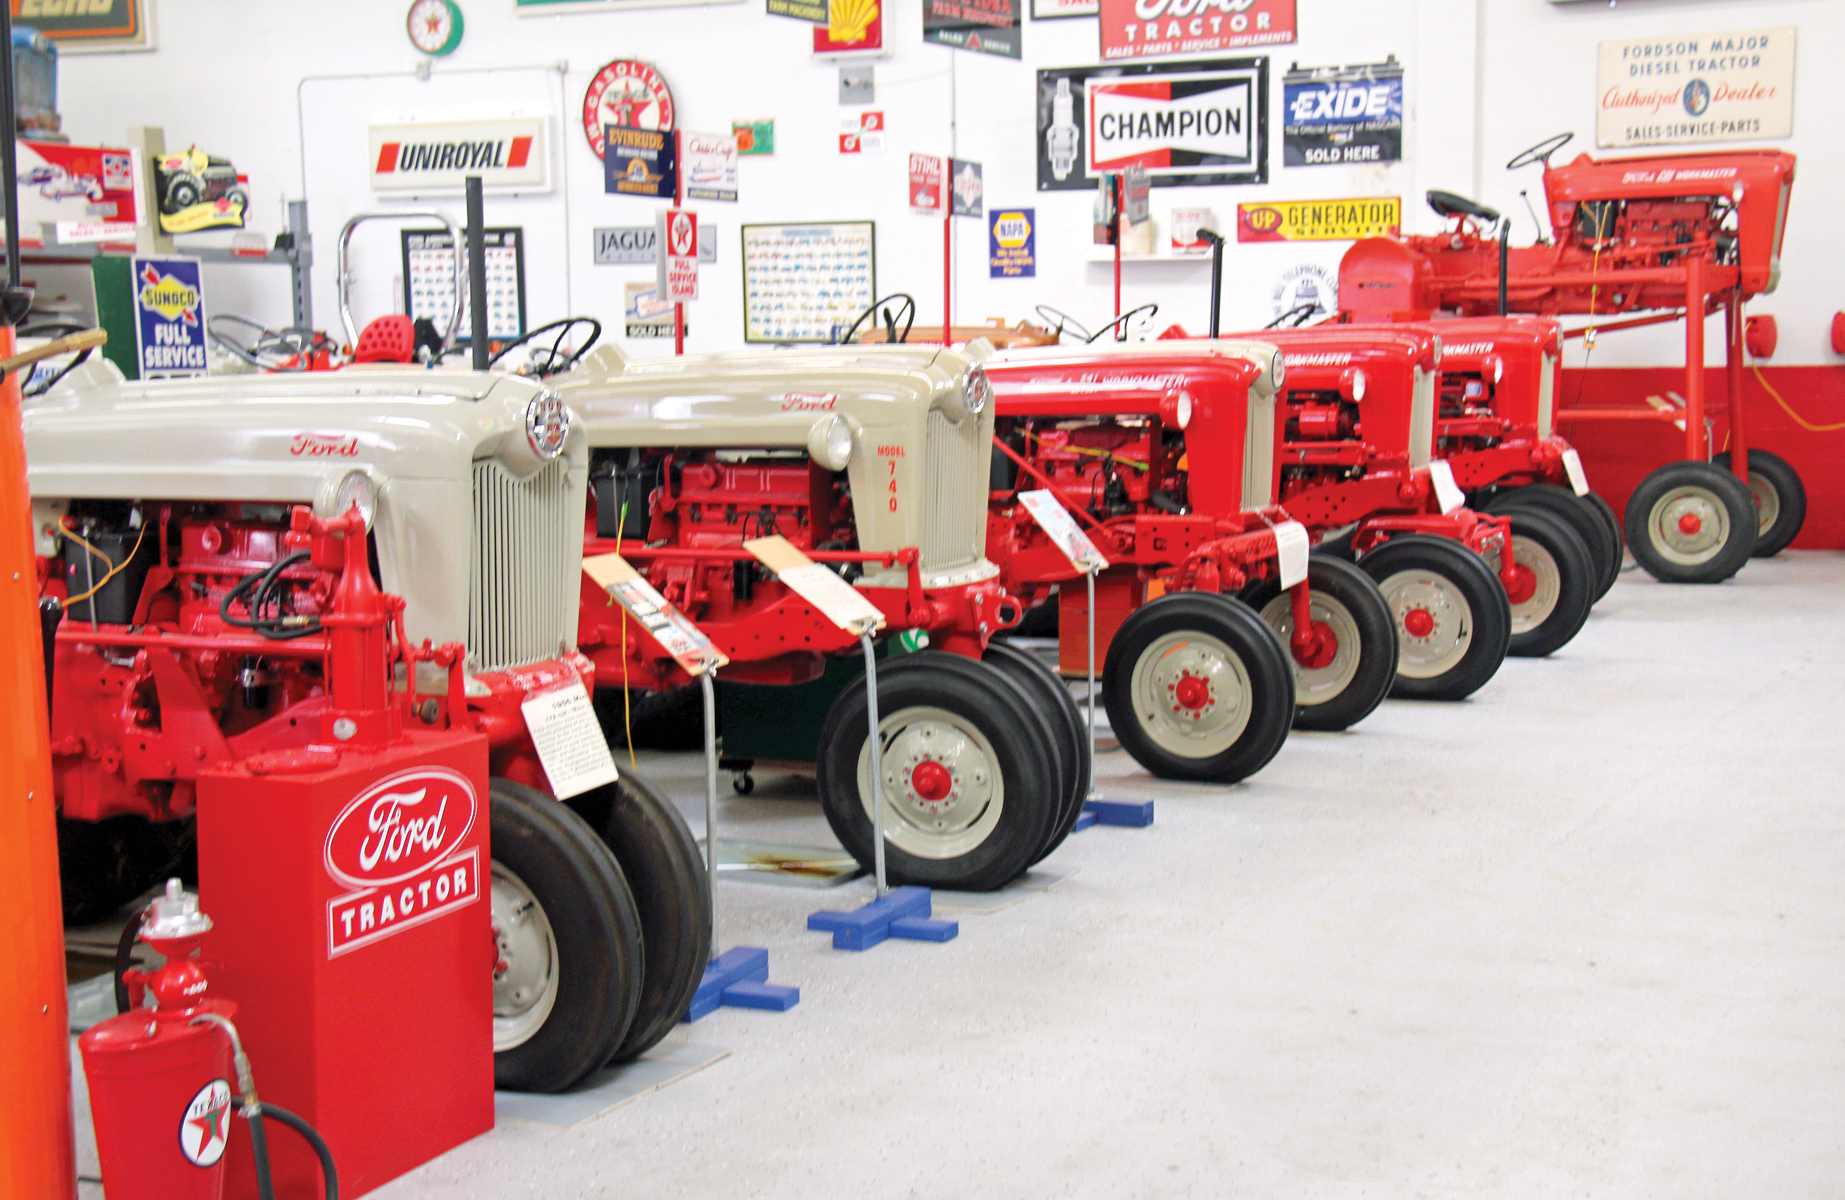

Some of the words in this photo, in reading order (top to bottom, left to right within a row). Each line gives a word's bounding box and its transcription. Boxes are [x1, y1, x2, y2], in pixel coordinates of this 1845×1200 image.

[1125, 12, 1272, 42] TRACTOR
[1106, 44, 1134, 58] SALES
[1142, 41, 1172, 55] PARTS
[1181, 37, 1220, 51] SERVICE
[1229, 31, 1292, 47] IMPLEMENTS
[1623, 41, 1699, 60] FORDSON
[1711, 35, 1769, 53] MAJOR
[1629, 60, 1680, 77] DIESEL
[1687, 54, 1761, 72] TRACTOR
[1289, 86, 1390, 120] EXIDE
[1602, 84, 1681, 115] Authorized
[1712, 80, 1777, 103] Dealer
[1100, 107, 1242, 140] CHAMPION
[1300, 123, 1326, 135] Official
[609, 127, 664, 151] EVINRUDE
[400, 140, 504, 172] UNIROYAL
[911, 155, 940, 176] STIHL
[1305, 147, 1340, 163] SOLD
[1344, 145, 1380, 161] HERE
[1674, 166, 1738, 181] WORKMASTER
[1288, 203, 1394, 226] GENERATOR
[1000, 222, 1024, 238] NAPA
[600, 229, 657, 256] JAGUA
[669, 272, 697, 284] SERVICE
[145, 289, 195, 306] SUNOCO
[155, 323, 191, 346] FULL
[145, 345, 205, 368] SERVICE
[1284, 352, 1352, 366] ORKMASTER
[782, 391, 838, 411] Ford
[290, 433, 360, 457] Ford
[877, 446, 905, 458] MODEL
[360, 786, 448, 871] Ford
[341, 867, 468, 938] TRACTOR
[193, 1090, 229, 1117] TEXACO
